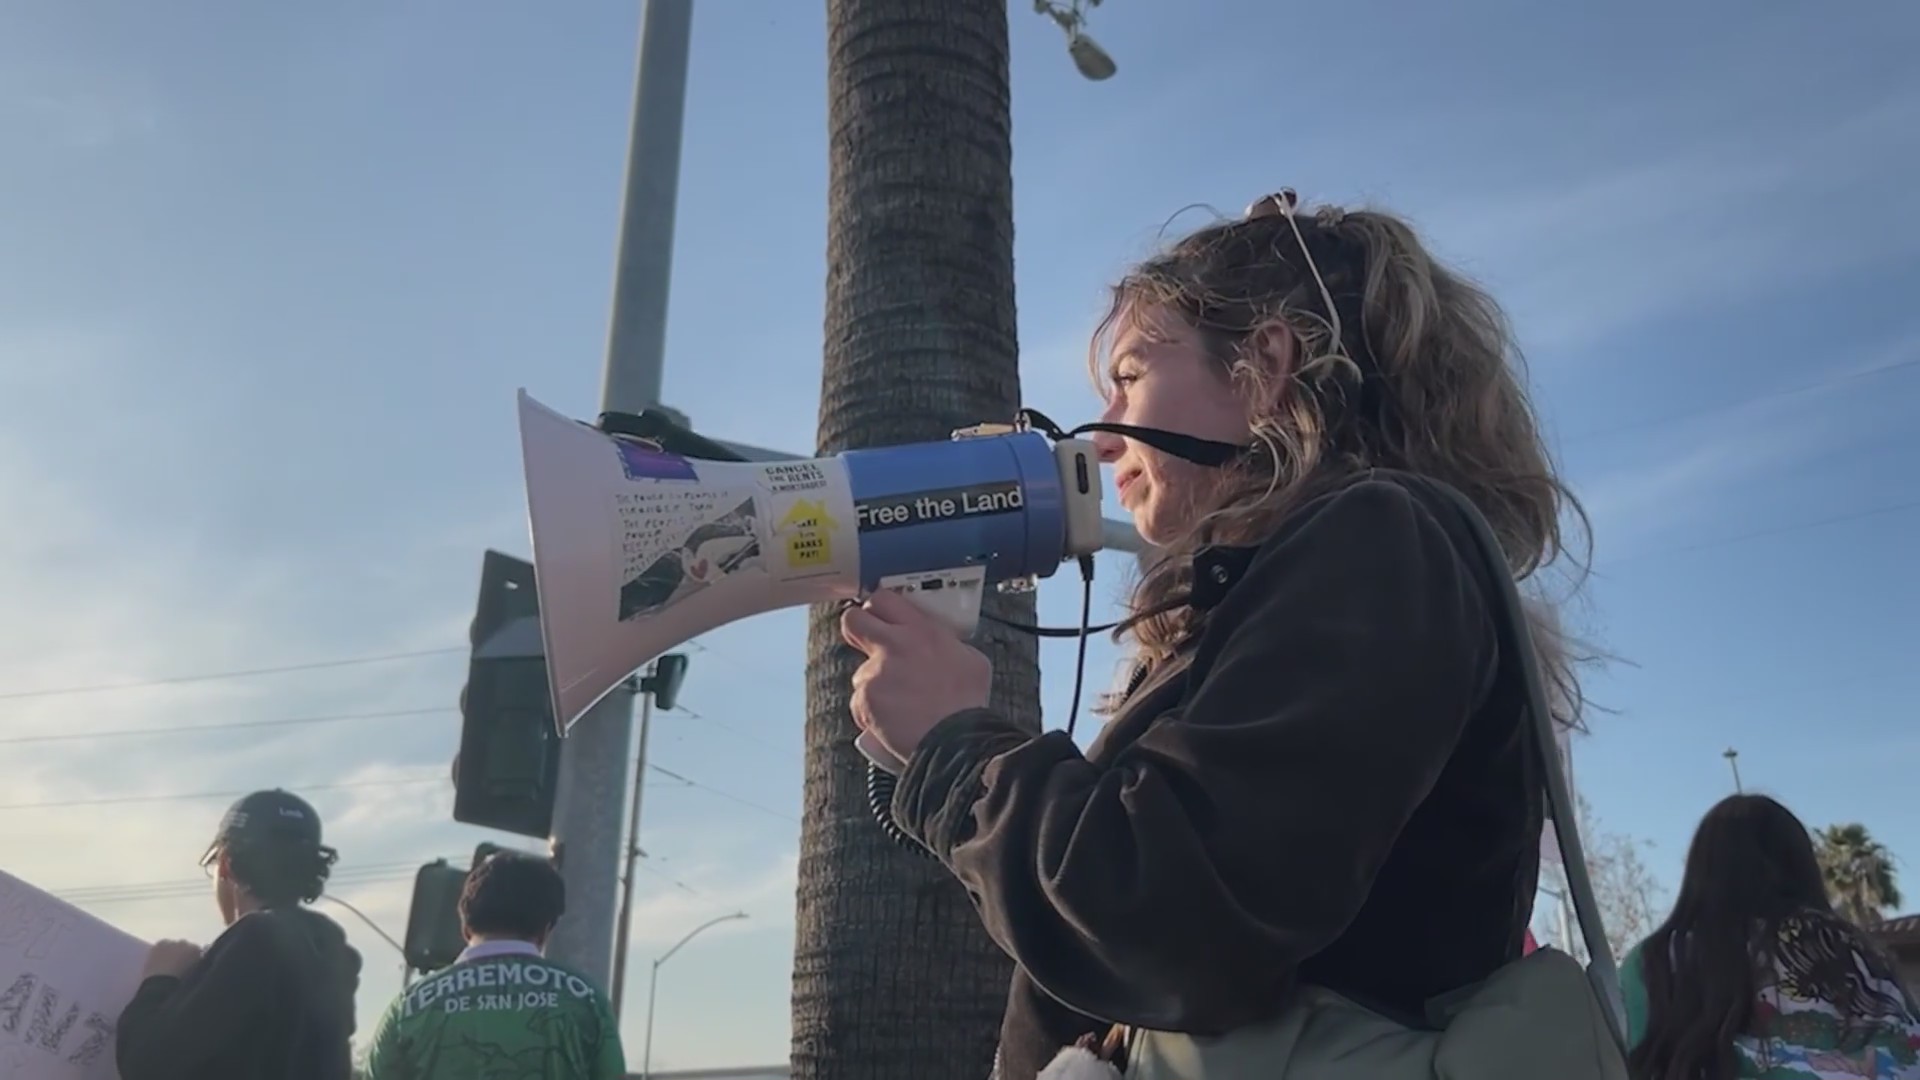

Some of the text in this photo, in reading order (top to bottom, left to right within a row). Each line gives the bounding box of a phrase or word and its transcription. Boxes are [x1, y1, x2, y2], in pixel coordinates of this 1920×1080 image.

[765, 463, 818, 475] CANCEL
[787, 470, 824, 482] RENTS
[855, 485, 1024, 527] Free the Land
[794, 539, 823, 550] BANKS
[445, 991, 559, 1013] DE SAN JOSE
